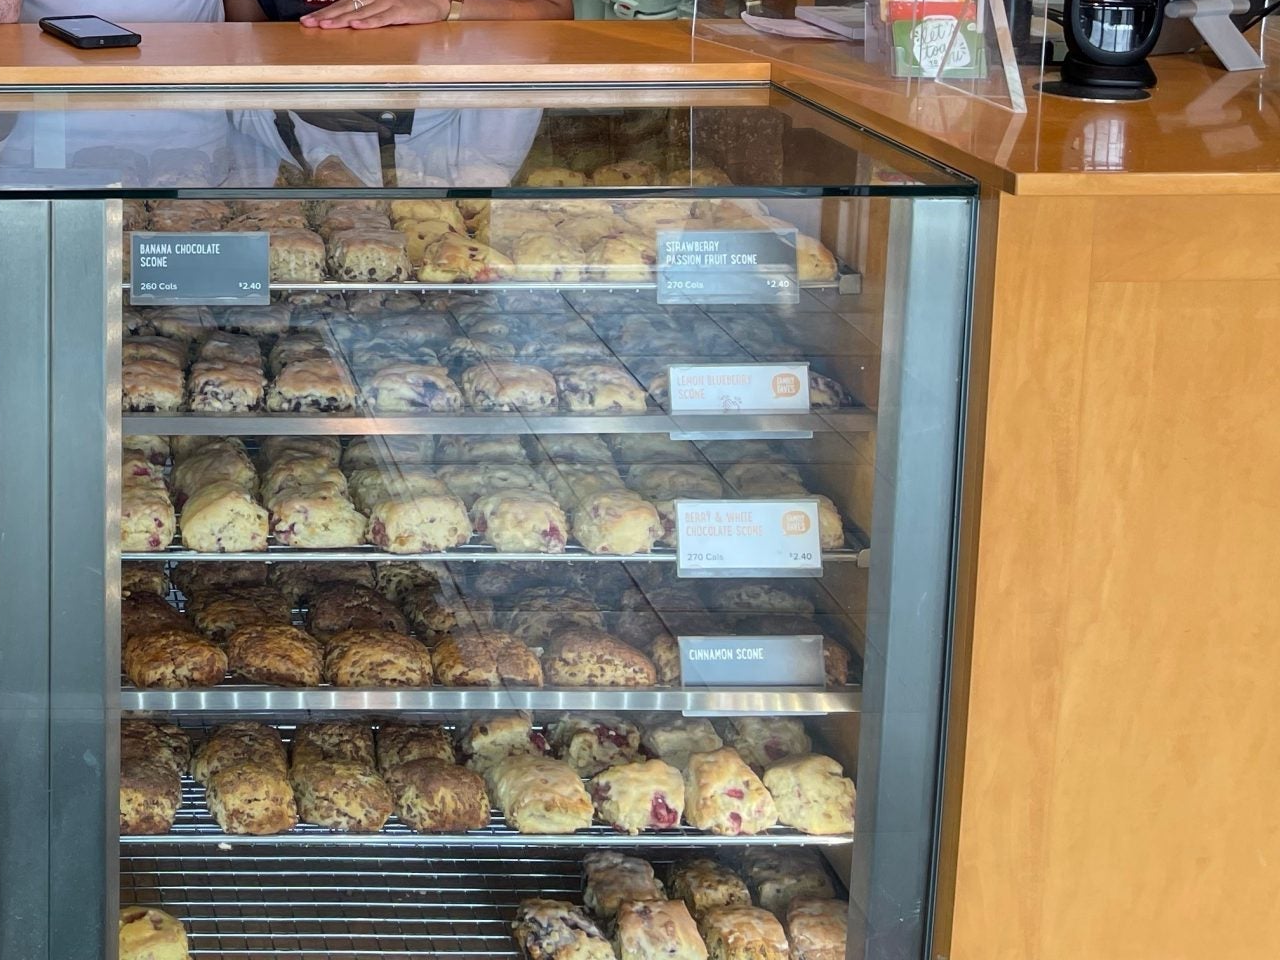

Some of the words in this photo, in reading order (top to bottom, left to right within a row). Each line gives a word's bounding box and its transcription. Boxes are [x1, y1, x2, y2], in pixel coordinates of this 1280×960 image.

[140, 244, 172, 254] BANANA
[175, 243, 220, 254] CHOCOLATE
[666, 241, 720, 252] STRAWBERRY
[140, 257, 168, 267] SCONE
[666, 254, 701, 265] PASSION
[704, 254, 727, 265] FRUIT
[731, 254, 758, 265] SCONE
[159, 282, 178, 290] Cals
[238, 282, 261, 290] $2.40
[667, 281, 683, 289] 270
[684, 280, 704, 289] Cals
[766, 280, 790, 288] $2.40
[676, 375, 704, 386] LEMON
[707, 374, 751, 386] BLUEBERRY
[678, 389, 705, 400] SCONE
[685, 512, 712, 523] BERRY
[728, 512, 753, 523] WHITE
[686, 525, 732, 537] CHOCOLATE
[736, 525, 763, 536] SCONE
[687, 553, 704, 561] 270
[706, 552, 724, 561] Cals
[789, 552, 813, 561] $2.40
[689, 649, 733, 660] CINNAMON
[736, 648, 764, 660] SCONE
